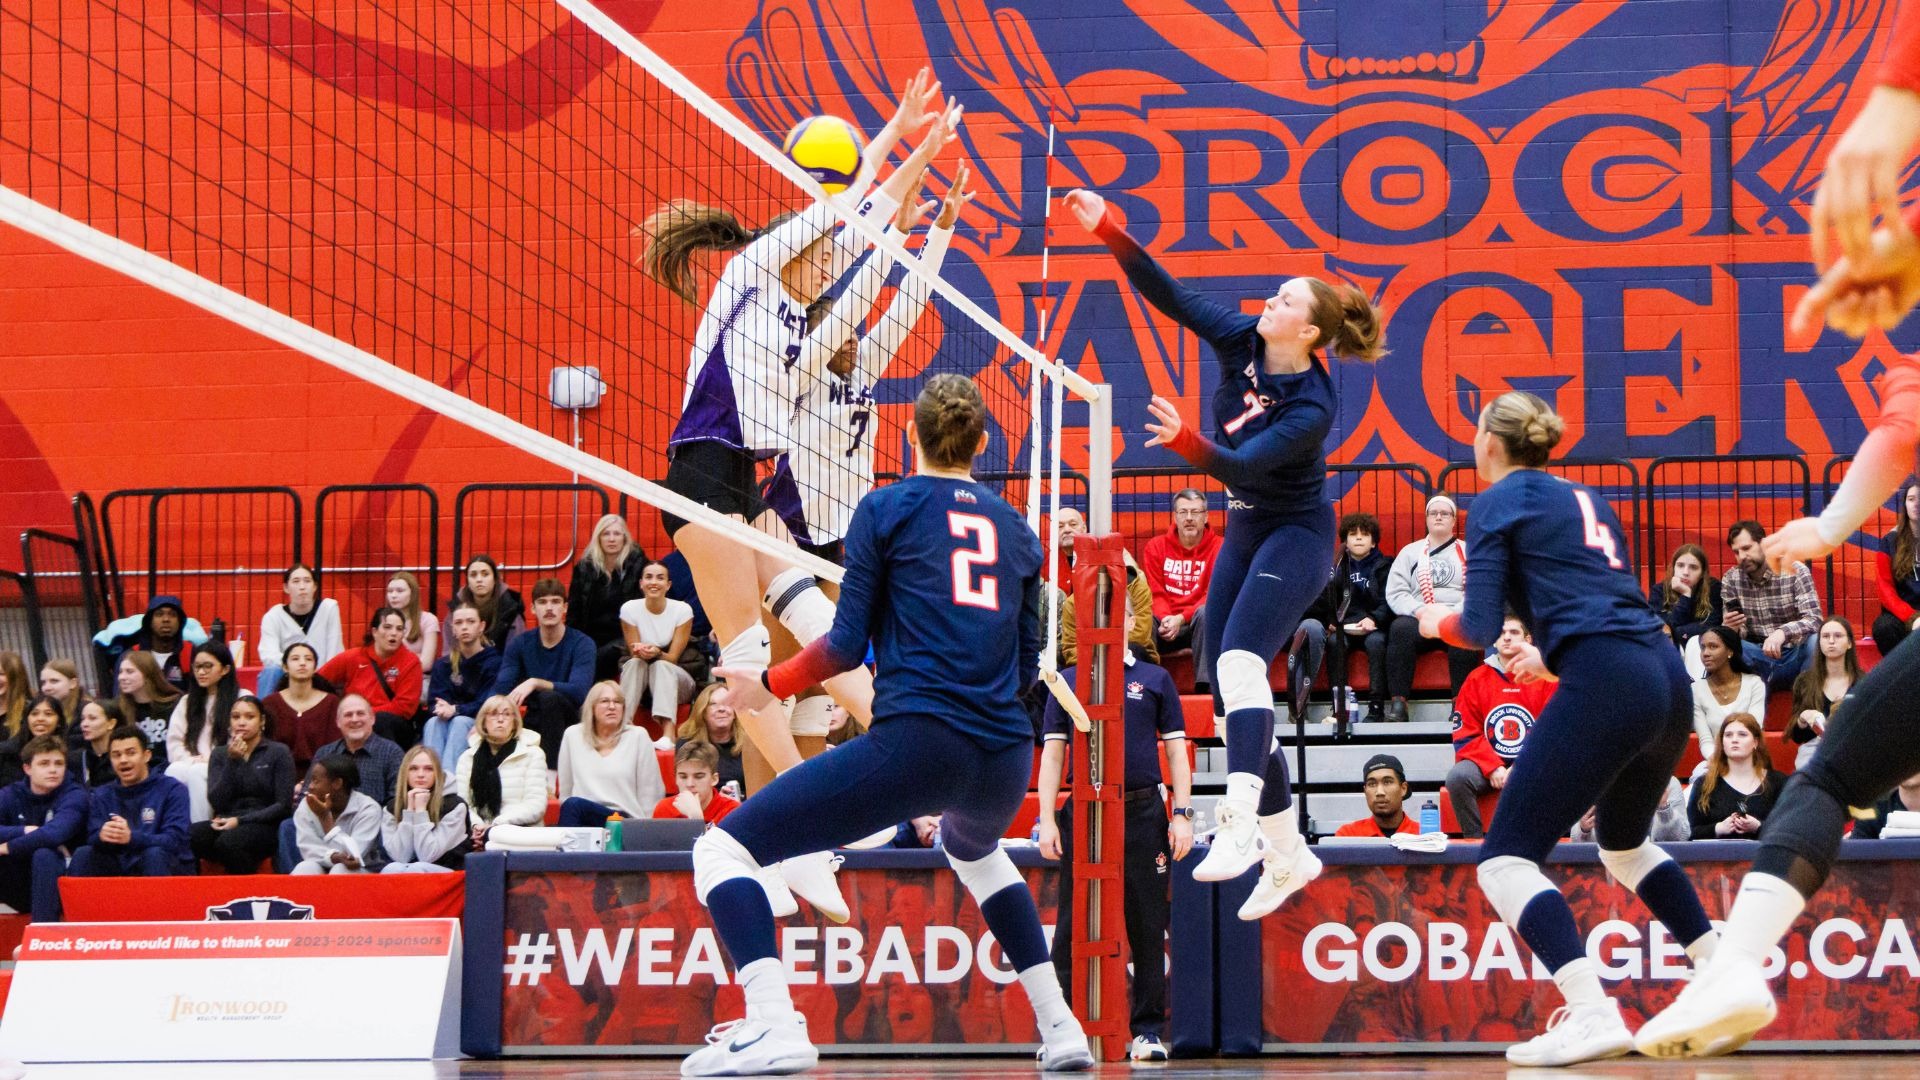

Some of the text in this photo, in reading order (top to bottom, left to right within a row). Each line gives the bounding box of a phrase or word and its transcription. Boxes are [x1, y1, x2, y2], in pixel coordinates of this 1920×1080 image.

[1000, 110, 1812, 256] BROCK
[838, 245, 1920, 480] AGER
[845, 410, 870, 458] 7
[1223, 389, 1267, 435] 7
[1572, 489, 1623, 569] 4
[946, 508, 1001, 612] 2
[1489, 707, 1533, 728] BROCK UNIVERSITY
[1500, 719, 1521, 741] B
[29, 935, 442, 952] Brock Sports would like to thank our 2023-2024 sponsors
[503, 925, 1171, 986] #WEAEBADG
[1301, 917, 1920, 983] GOBAGE.CA
[168, 992, 288, 1022] IRONWOOD
